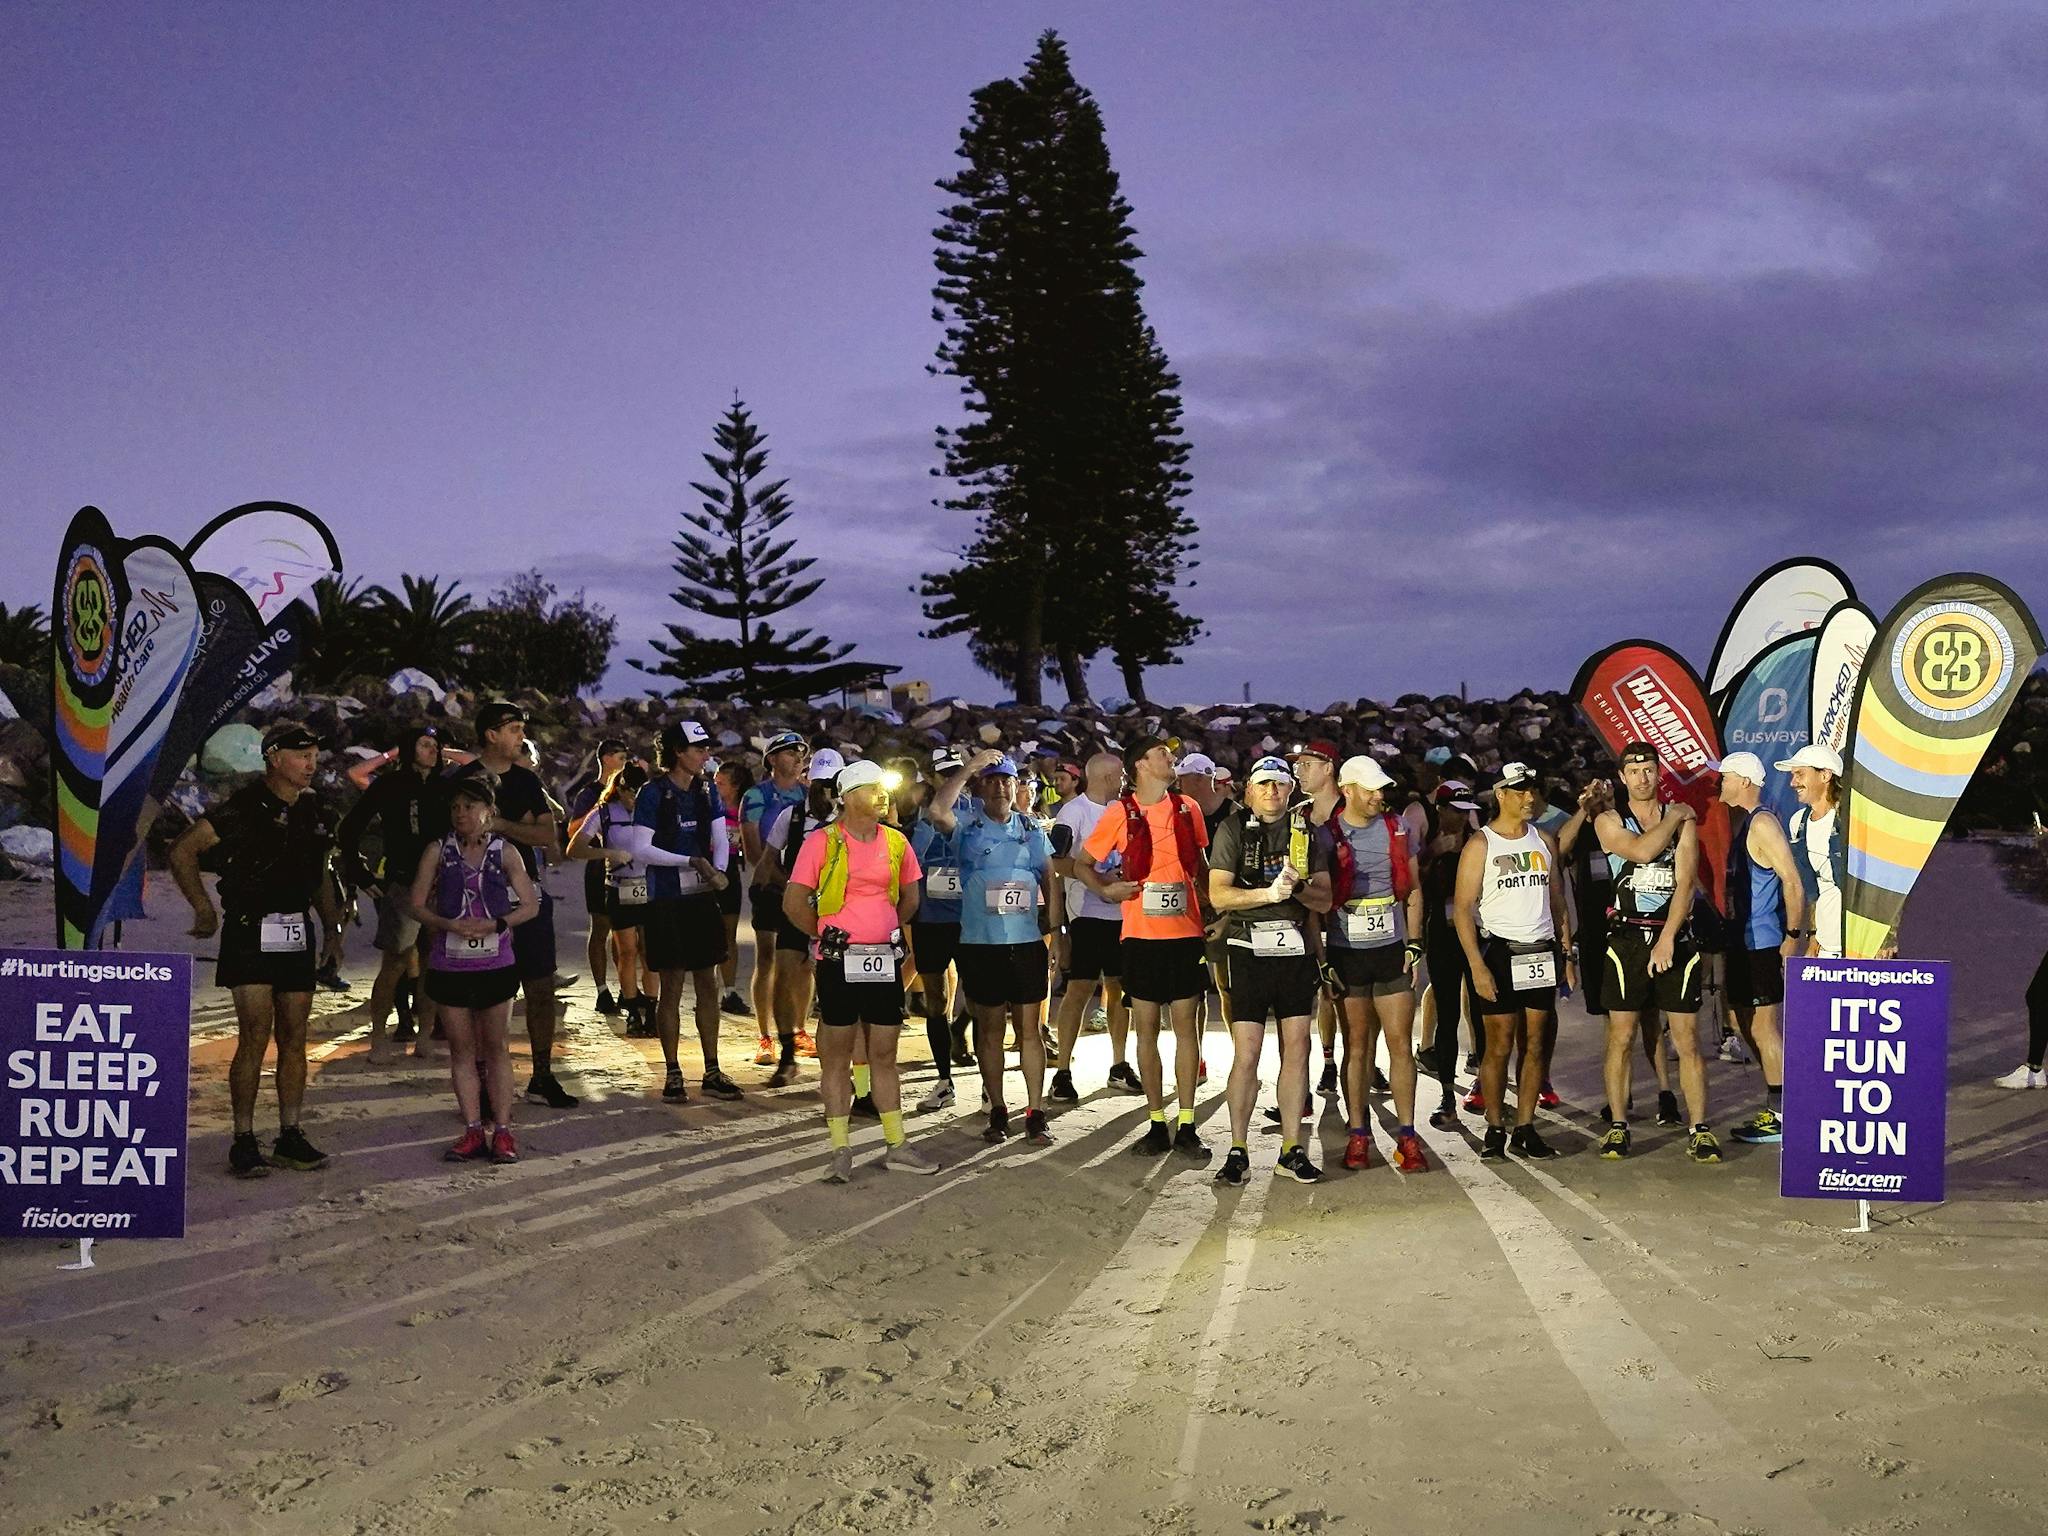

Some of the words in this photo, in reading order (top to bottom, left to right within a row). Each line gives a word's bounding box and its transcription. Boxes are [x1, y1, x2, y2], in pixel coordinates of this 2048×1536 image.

[1593, 692, 1636, 745] ENDURAN
[1626, 675, 1708, 770] HAMMER
[1732, 729, 1809, 746] Busways
[632, 886, 646, 898] 62
[1497, 875, 1526, 890] PORT
[1005, 891, 1021, 905] 67
[1161, 893, 1179, 908] 56
[283, 926, 301, 941] 75
[1367, 916, 1385, 931] 34
[1276, 932, 1286, 947] 2
[1, 958, 172, 983] #hurtingsucks
[863, 957, 882, 972] 60
[1528, 963, 1545, 979] 35
[1801, 965, 1934, 986] #hurtingsucks
[36, 1003, 136, 1049] EAT,
[1830, 997, 1903, 1033] IT'S
[1824, 1038, 1906, 1074] FUN
[7, 1050, 160, 1097] SLEEP,
[1835, 1079, 1892, 1115] TO
[19, 1098, 146, 1143] RUN,
[1820, 1119, 1906, 1155] RUN
[0, 1146, 177, 1186] REPEAT
[1818, 1167, 1902, 1189] fisiocrem
[22, 1206, 131, 1228] fisiocrem
